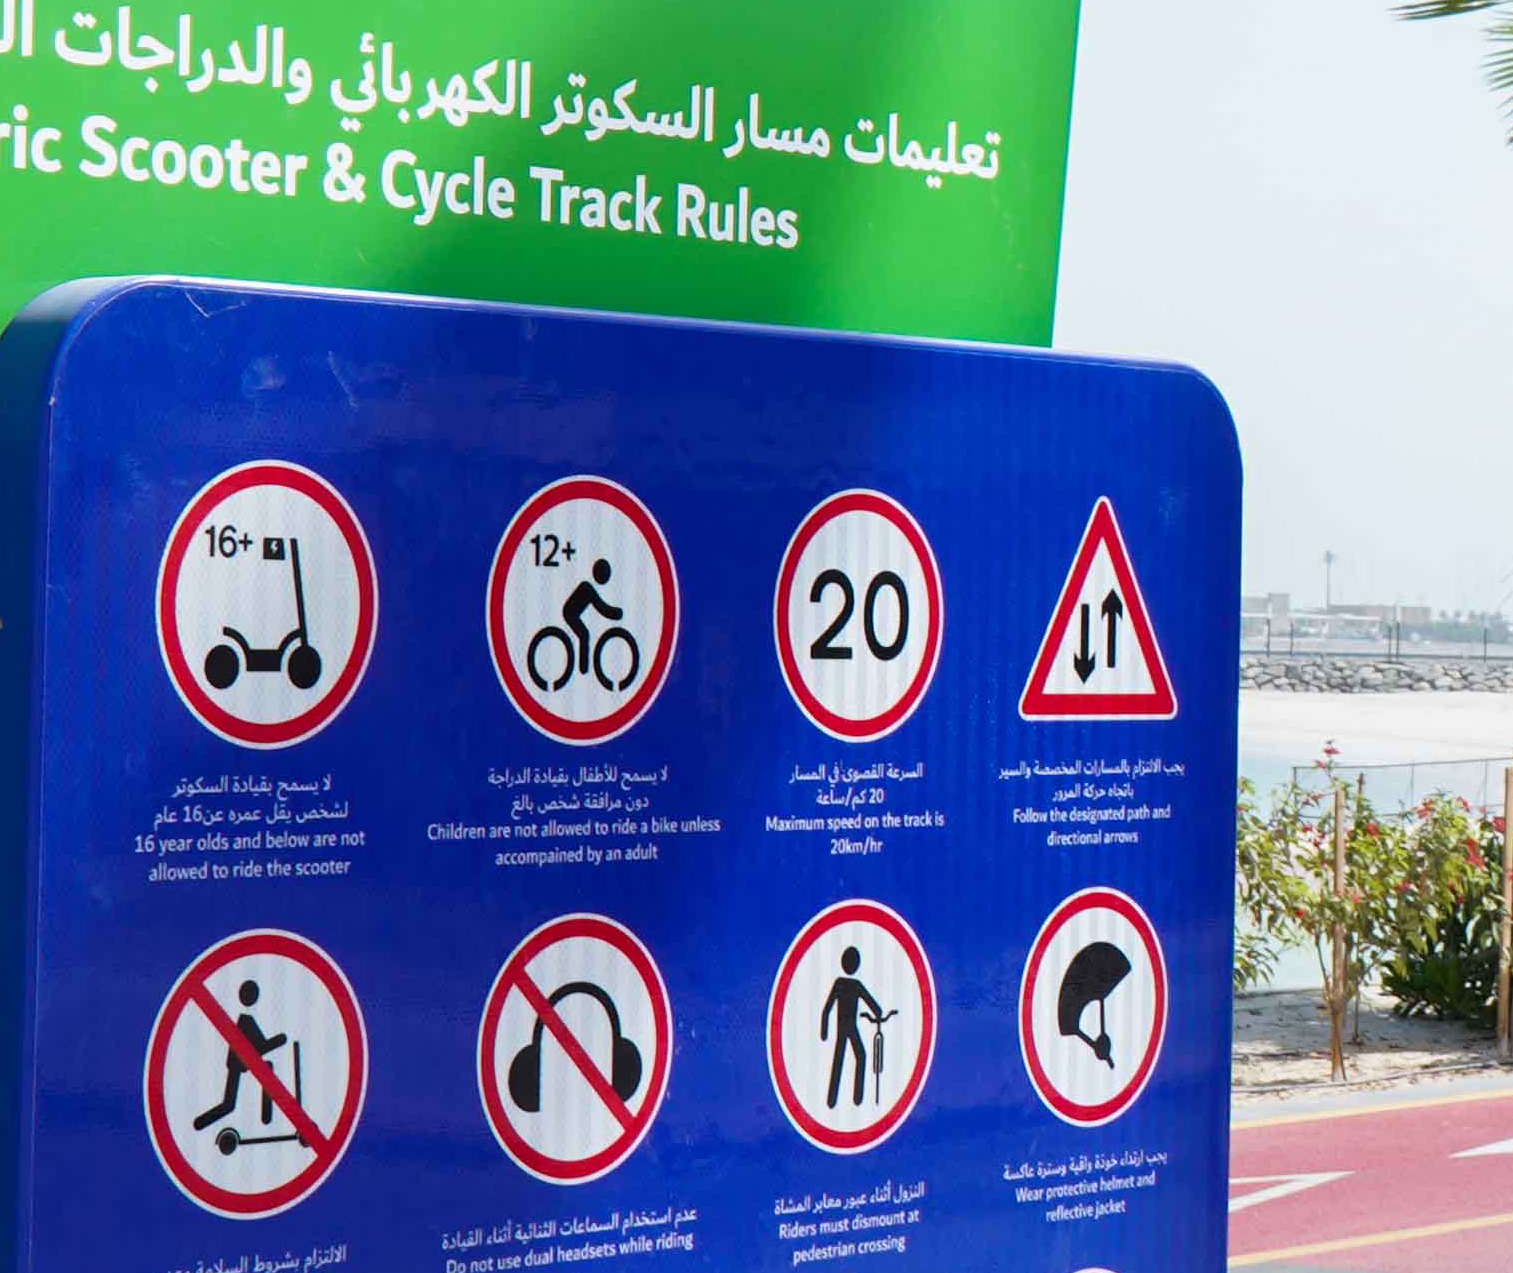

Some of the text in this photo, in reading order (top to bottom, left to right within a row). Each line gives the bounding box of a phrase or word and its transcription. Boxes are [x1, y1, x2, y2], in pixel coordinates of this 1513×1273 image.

[55, 6, 315, 107] والدراجات
[331, 33, 533, 134] الكهربائي
[541, 73, 715, 143] السكوتر
[723, 93, 831, 159] مسار
[845, 113, 1003, 190] تعليمات
[79, 115, 311, 198] Scooter
[323, 143, 368, 205] &
[381, 149, 516, 227] Cycle
[530, 167, 663, 235] Track
[678, 183, 799, 249] Rules
[204, 524, 254, 559] 16+
[529, 533, 577, 568] 12+
[808, 568, 911, 662] 20
[427, 815, 721, 841] Children are not allowed to ride a bike unless
[766, 811, 945, 832] Maximum speed on the track is
[1013, 804, 1171, 825] Follow the designated path and
[135, 831, 365, 857] 16 year olds and below are not
[831, 836, 883, 855] 20km/hr
[1047, 829, 1139, 846] directional arrows
[149, 859, 351, 882] allowed to ride the scooter
[495, 843, 658, 867] accompained by an adult
[1015, 1170, 1156, 1203] Wear protective helmet and
[779, 1210, 920, 1239] Riders must dismount at
[1046, 1199, 1126, 1222] reflective jacket
[470, 1258, 494, 1273] not
[497, 1255, 522, 1270] use
[524, 1247, 554, 1267] dual
[557, 1242, 617, 1262] headsets
[619, 1235, 654, 1255] while
[656, 1231, 695, 1251] riding
[793, 1235, 906, 1267] pedestrian crossing
